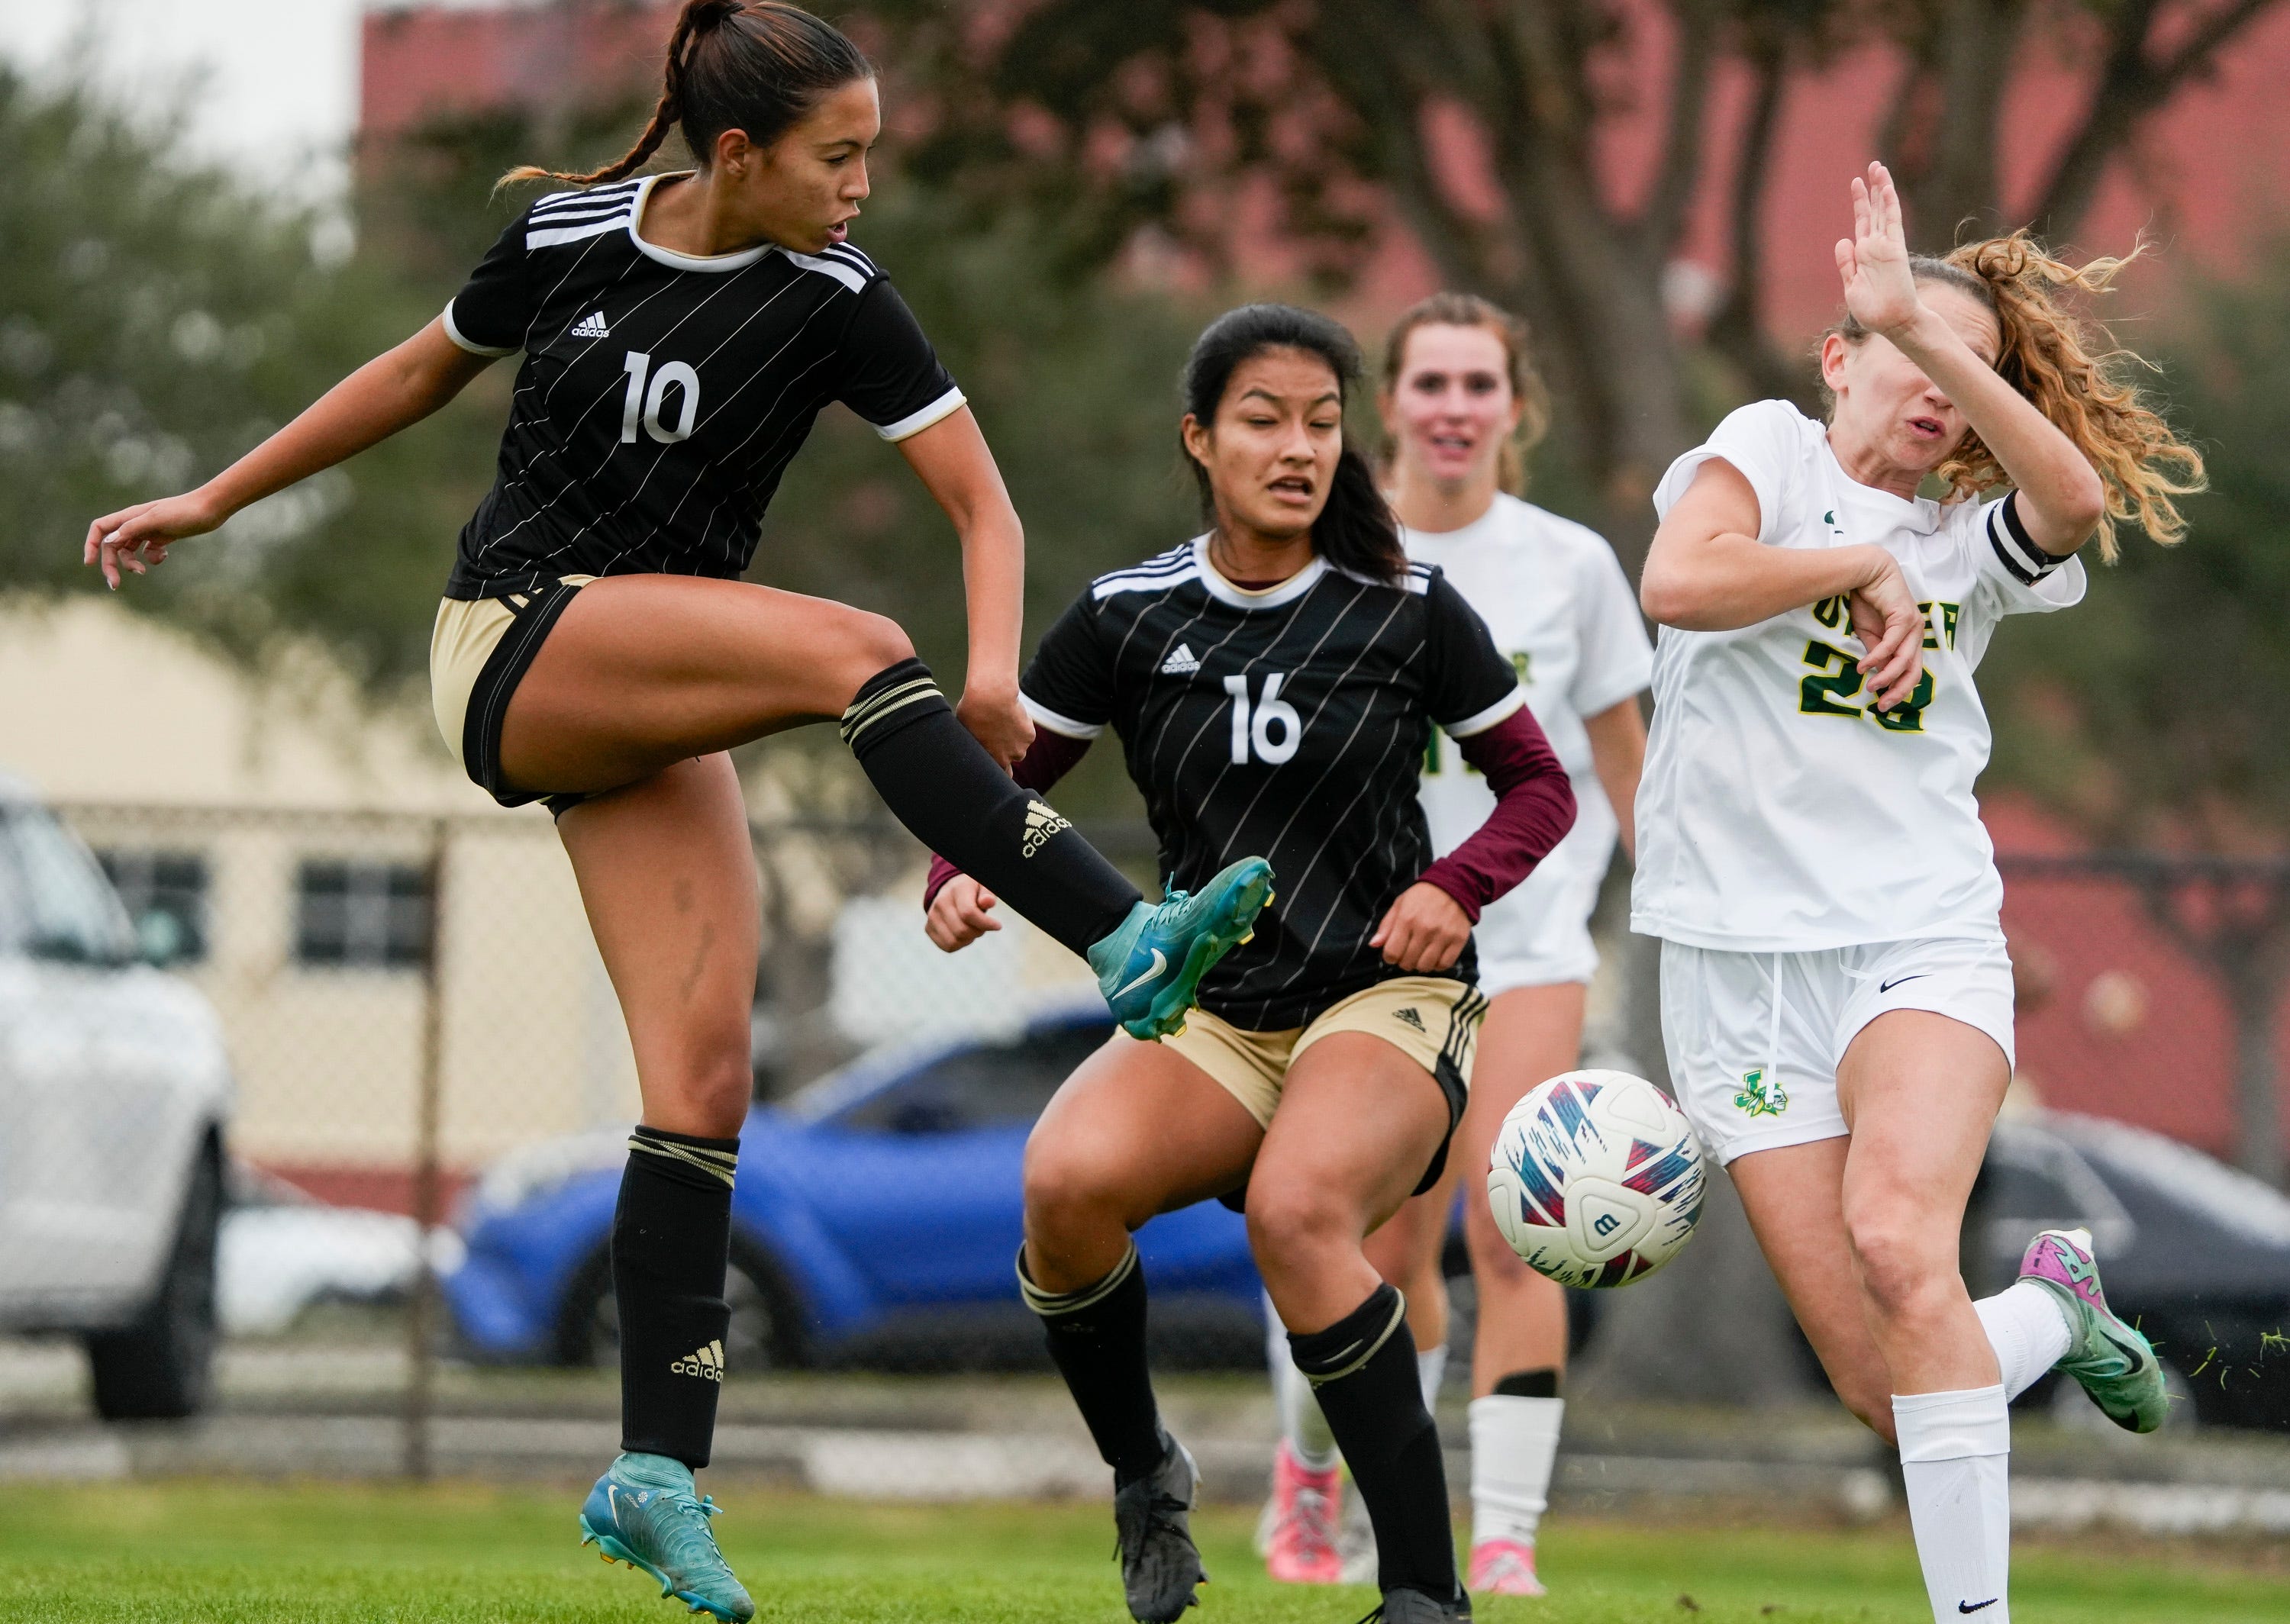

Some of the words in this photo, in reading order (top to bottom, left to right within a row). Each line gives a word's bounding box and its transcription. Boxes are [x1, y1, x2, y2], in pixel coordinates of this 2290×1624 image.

[572, 327, 610, 338] adidas
[621, 350, 700, 443] 10
[1224, 672, 1301, 765] 16
[1022, 817, 1072, 859] adidas
[671, 1361, 724, 1382] adida
